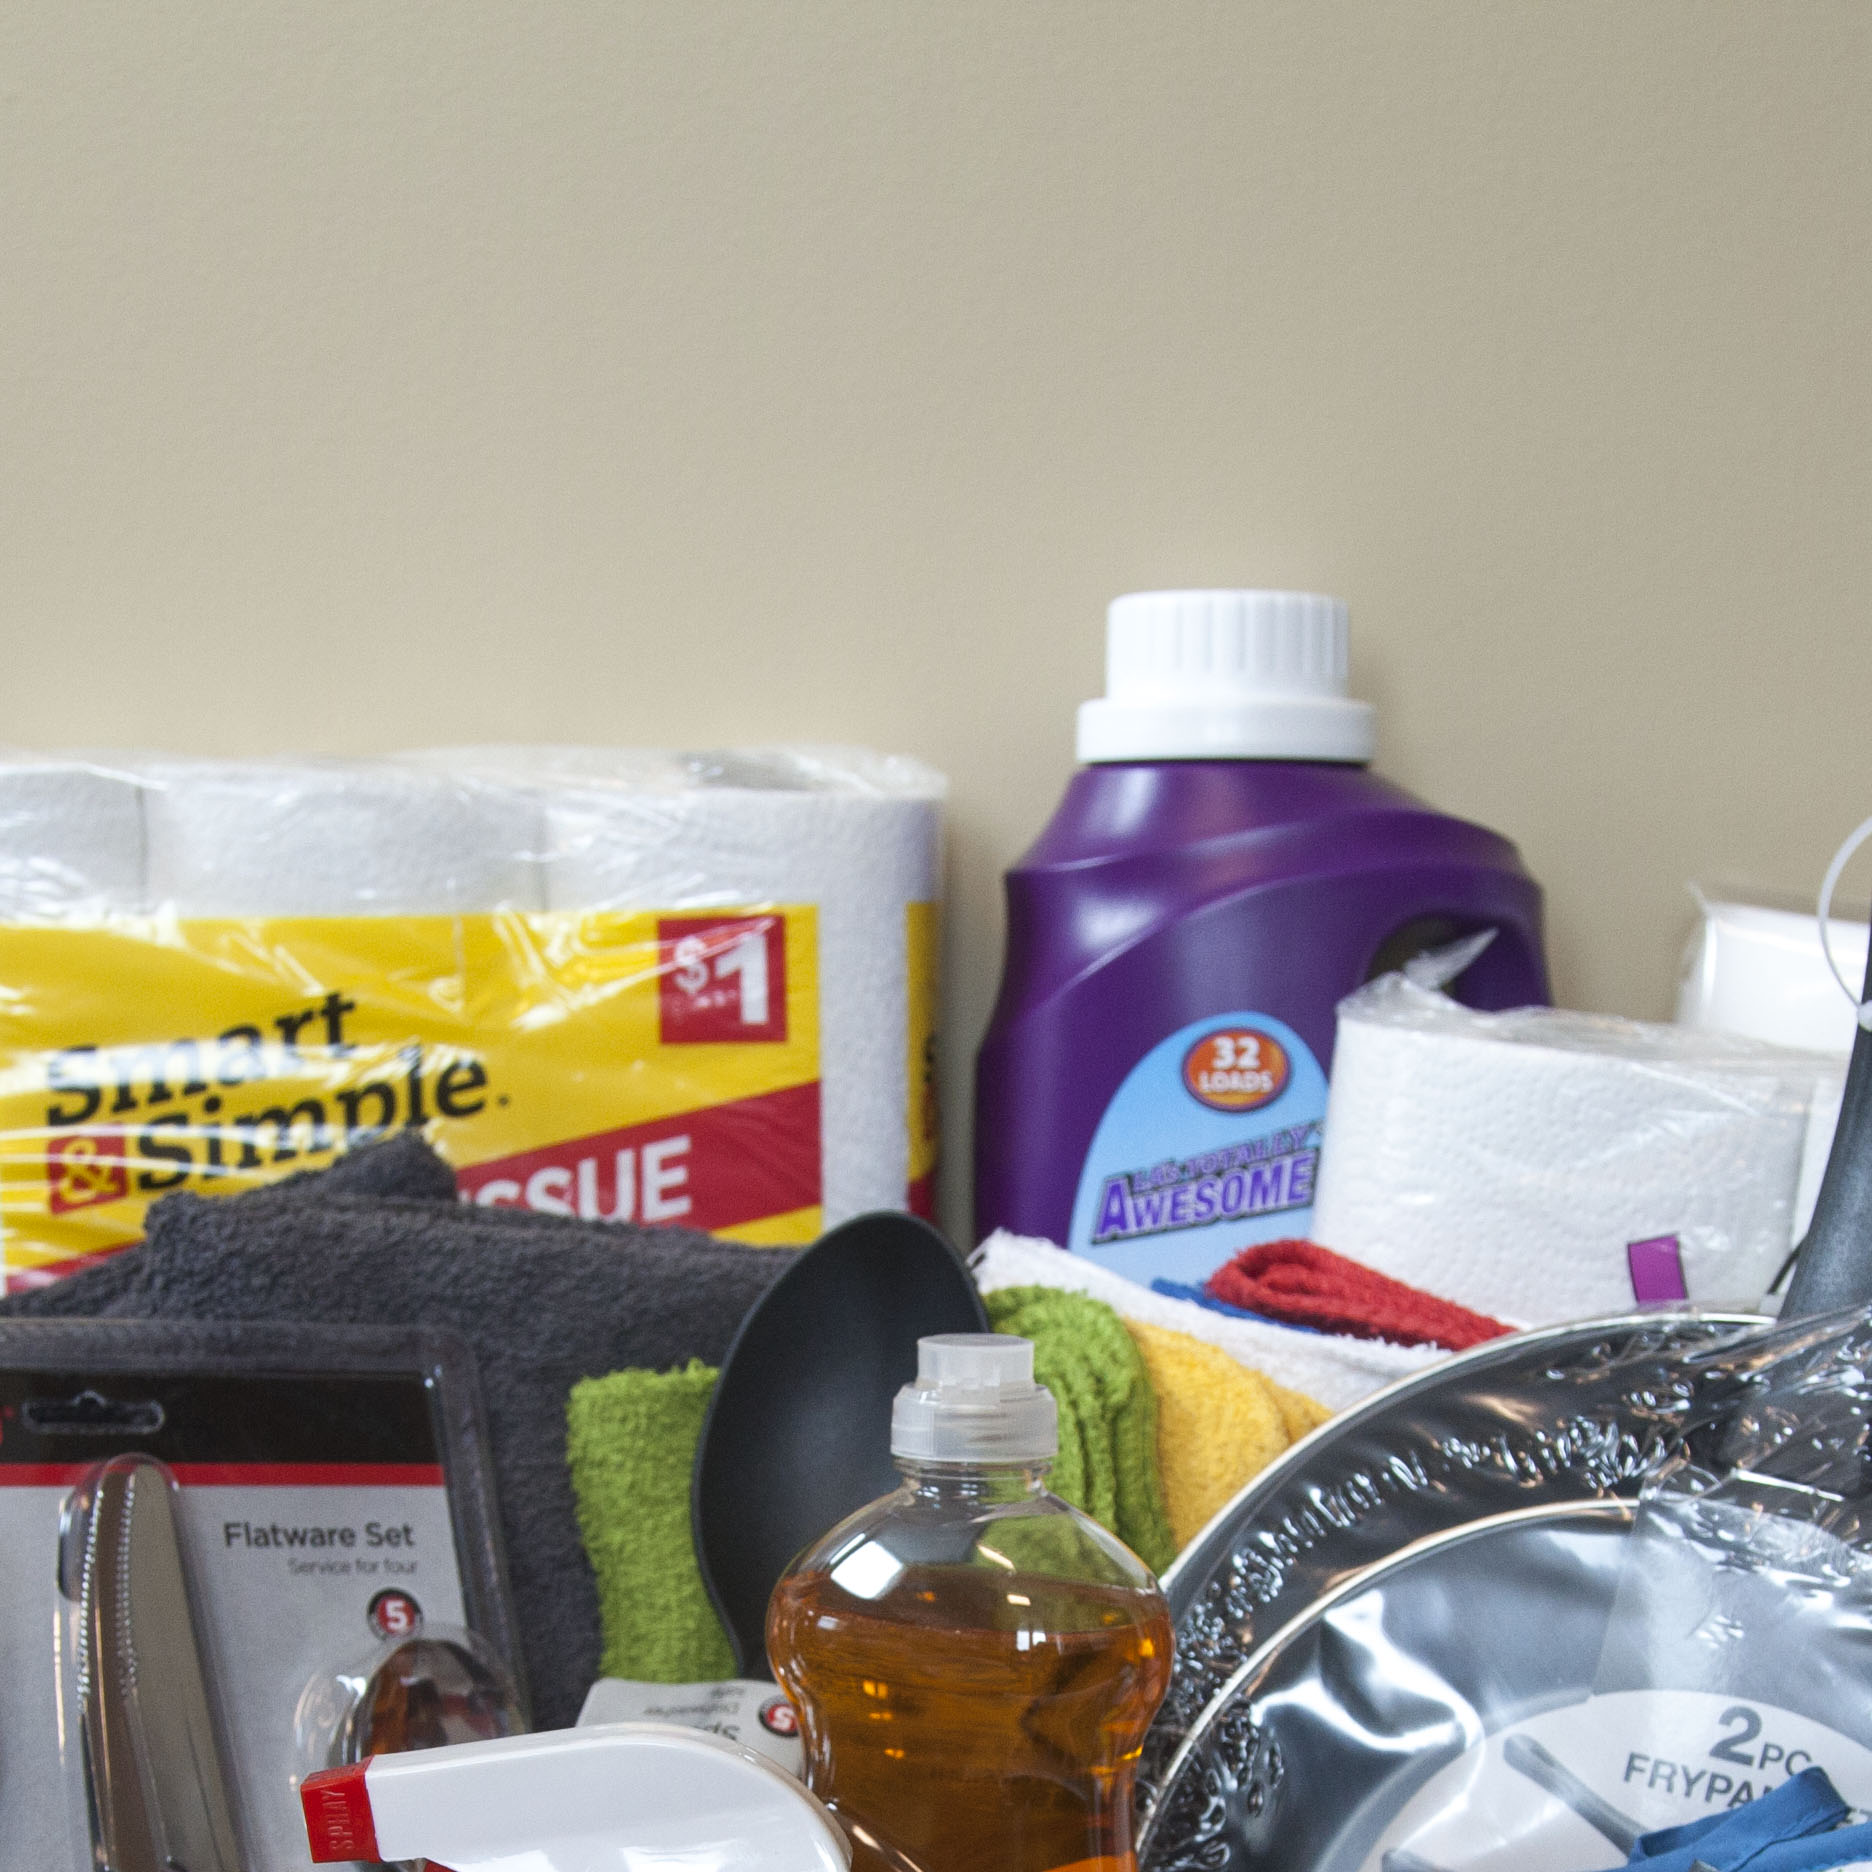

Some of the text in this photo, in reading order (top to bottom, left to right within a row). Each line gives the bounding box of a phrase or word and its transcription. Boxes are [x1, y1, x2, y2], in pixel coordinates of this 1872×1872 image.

[673, 931, 769, 1025] $1
[47, 991, 357, 1127] Smart
[1213, 1037, 1260, 1069] 32
[1198, 1070, 1273, 1094] LOADS
[1184, 1124, 1311, 1176] TOTALLY
[1095, 1152, 1317, 1238] AWESOME
[223, 1521, 416, 1547] Flatware Set
[288, 1557, 418, 1575] Service for four
[1623, 1751, 1773, 1808] FRYPA
[319, 1789, 354, 1849] SPRAY
